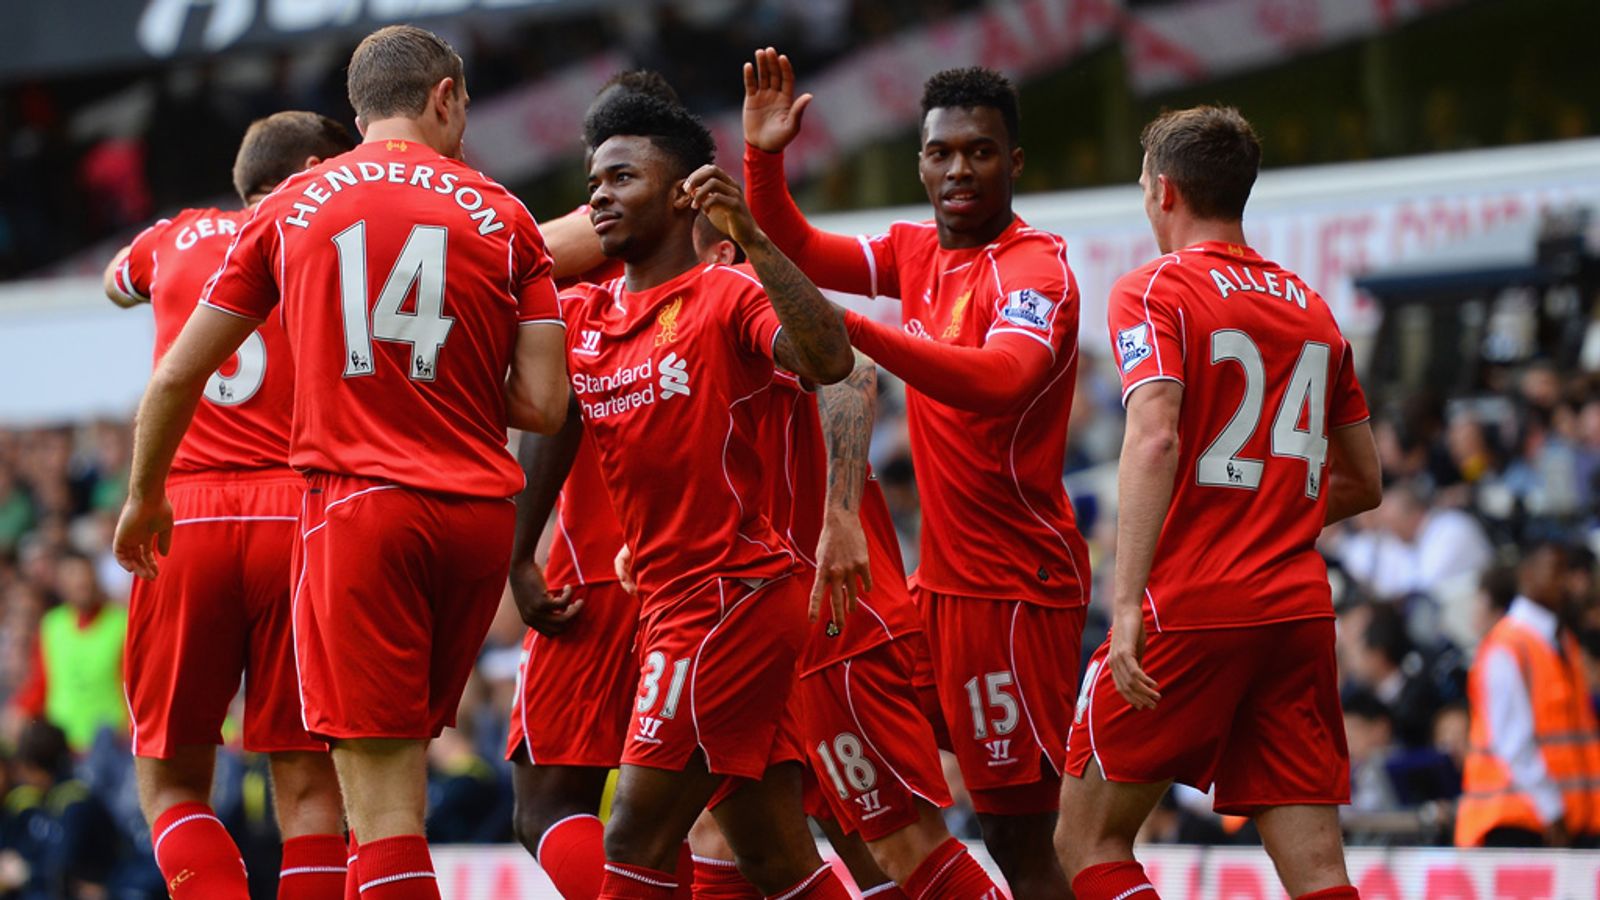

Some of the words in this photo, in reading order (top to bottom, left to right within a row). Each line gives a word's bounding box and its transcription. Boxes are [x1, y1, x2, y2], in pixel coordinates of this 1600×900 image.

[286, 162, 505, 236] HENDERSON
[331, 219, 455, 382] 14
[1209, 266, 1307, 309] ALLEN
[572, 357, 653, 395] Standard
[581, 382, 655, 420] hartered
[1196, 329, 1330, 499] 24
[637, 650, 692, 720] 31
[964, 670, 1019, 740] 15
[816, 732, 877, 801] 18
